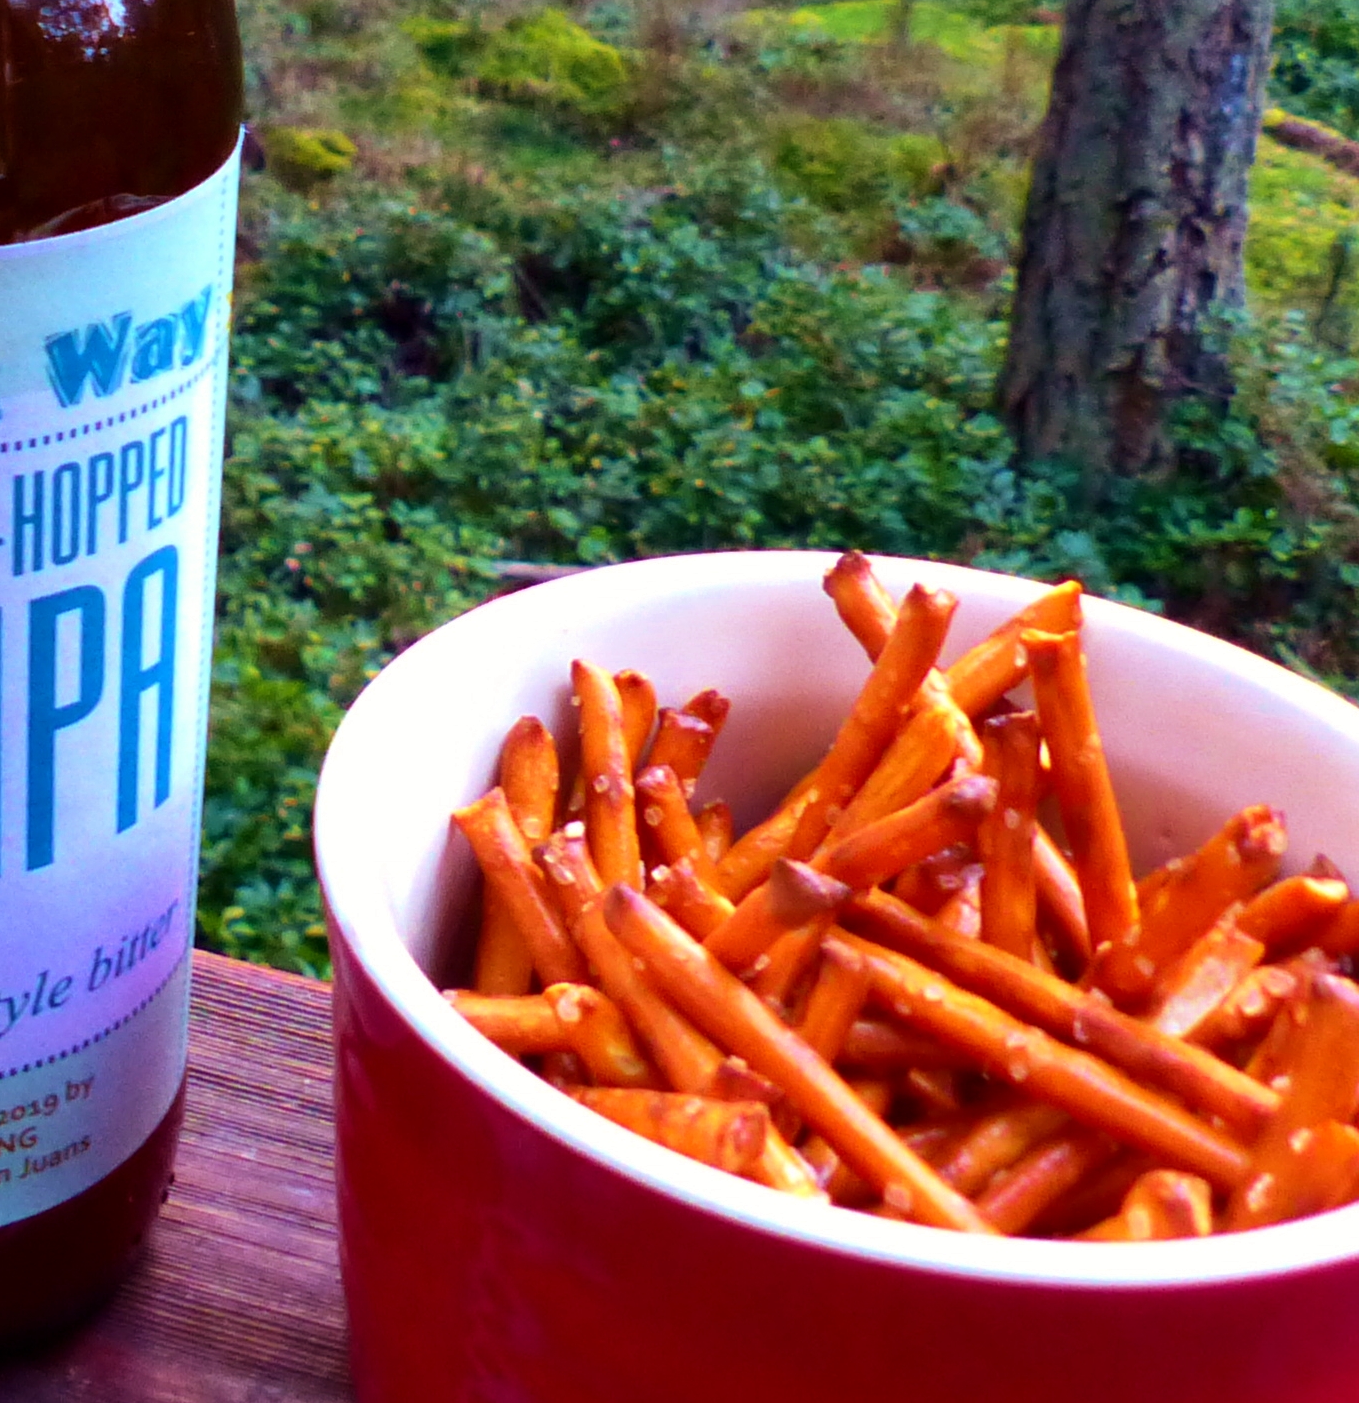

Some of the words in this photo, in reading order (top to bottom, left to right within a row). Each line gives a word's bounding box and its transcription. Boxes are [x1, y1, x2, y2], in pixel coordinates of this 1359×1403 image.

[44, 284, 214, 409] Way
[88, 899, 180, 992] bitter
[66, 1074, 96, 1102] by
[19, 1135, 91, 1179] Juans
